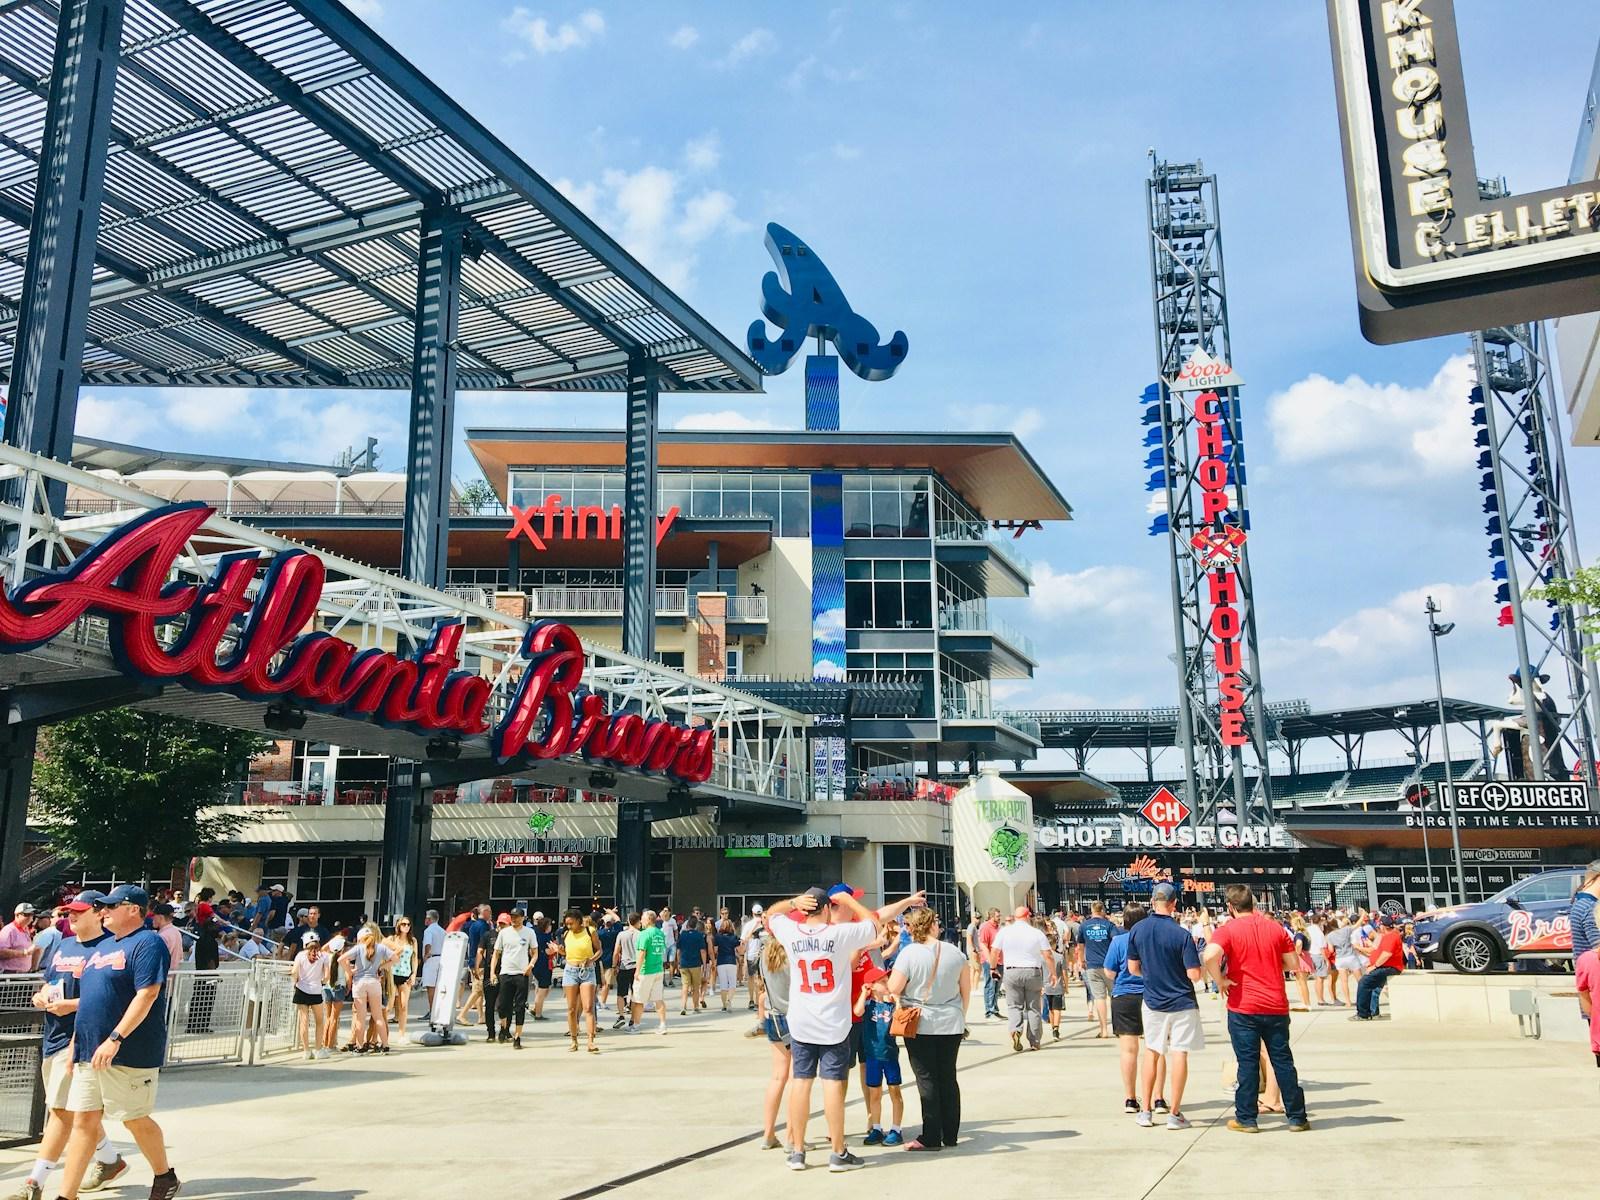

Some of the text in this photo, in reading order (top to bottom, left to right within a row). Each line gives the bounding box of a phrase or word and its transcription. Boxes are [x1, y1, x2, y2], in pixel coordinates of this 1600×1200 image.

[1179, 361, 1233, 379] Coors
[1189, 375, 1224, 387] LIGHT
[506, 494, 680, 550] xfiniy
[1194, 391, 1248, 746] CHOP HOUSE
[0, 501, 714, 783] Atlanta Braves
[1509, 786, 1584, 807] BURGER
[1150, 801, 1181, 822] CH
[1474, 815, 1510, 827] TIME
[1517, 815, 1544, 827] ALL
[1551, 815, 1579, 827] THE
[466, 838, 539, 855] TERRAPIN
[727, 832, 766, 849] FRESH
[767, 832, 803, 849] BREW
[805, 831, 832, 848] BAR
[1038, 826, 1286, 848] CHOP HOUSE GATE
[510, 855, 524, 864] FOX
[525, 855, 546, 863] BROS.
[1499, 850, 1533, 859] EVERYDAY
[1488, 875, 1504, 883] FRIES
[1507, 910, 1572, 950] Bra
[797, 959, 835, 994] 13
